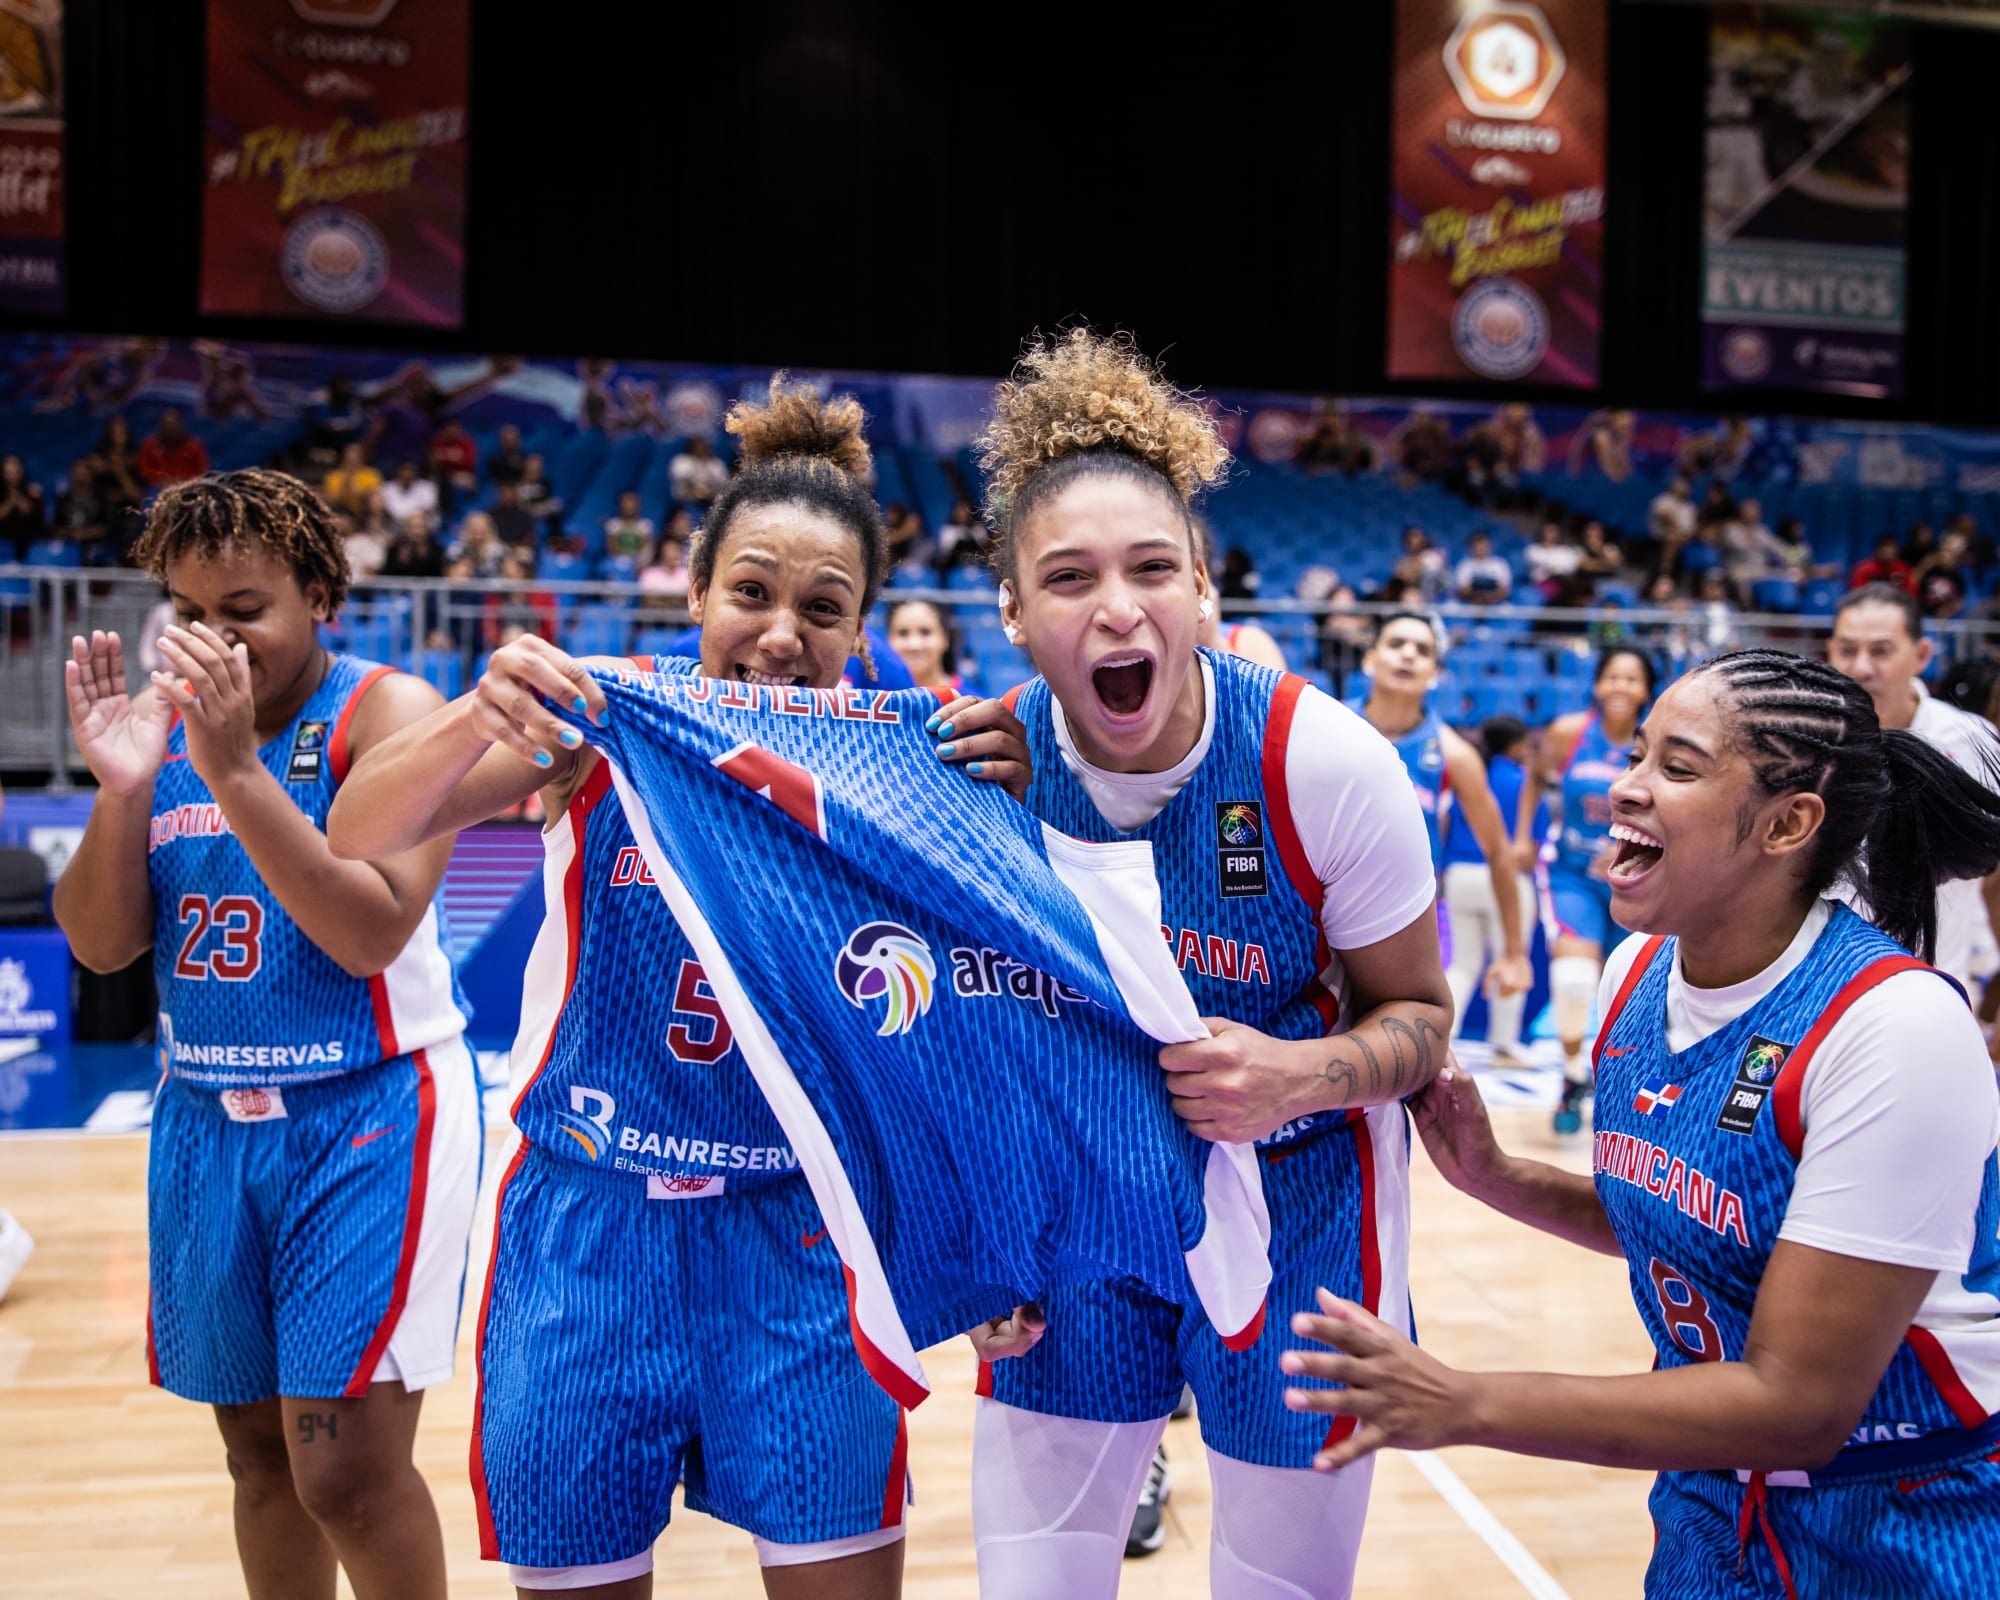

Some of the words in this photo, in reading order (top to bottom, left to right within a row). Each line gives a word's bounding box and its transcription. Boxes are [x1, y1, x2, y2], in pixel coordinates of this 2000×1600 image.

[1706, 266, 1894, 316] EVENTOS
[150, 803, 234, 853] DOMIN
[1226, 856, 1259, 872] FIBA
[175, 894, 264, 982] 23
[665, 958, 735, 1066] 5
[175, 1041, 344, 1068] BANRESERVAS
[1731, 1090, 1762, 1109] FIBA
[614, 1156, 628, 1170] El
[629, 1160, 671, 1179] banco
[1649, 1256, 1725, 1362] 8
[297, 1412, 337, 1444] 94
